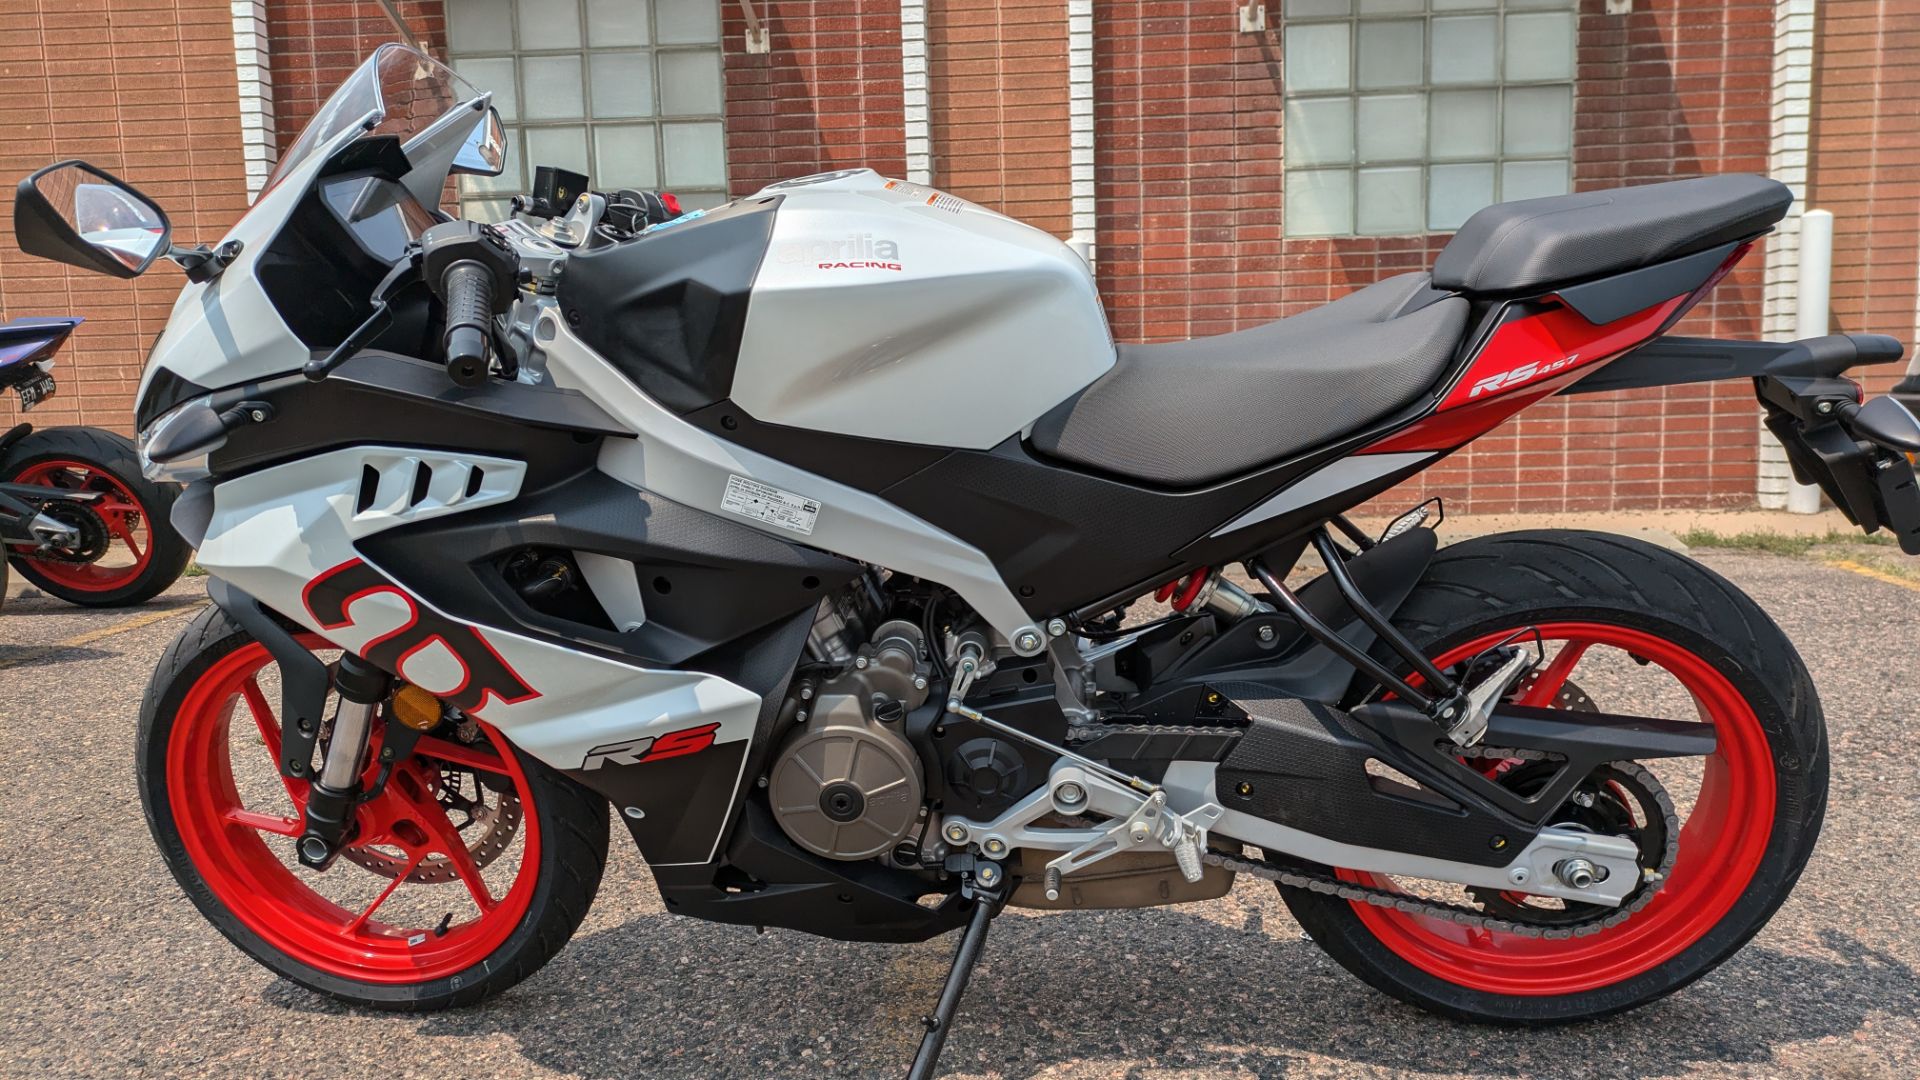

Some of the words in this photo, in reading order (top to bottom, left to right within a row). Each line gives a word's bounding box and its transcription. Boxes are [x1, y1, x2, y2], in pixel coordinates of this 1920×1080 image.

[778, 232, 899, 267] aprilia
[818, 261, 902, 271] RACING
[1469, 361, 1540, 398] RS
[581, 722, 721, 771] RS
